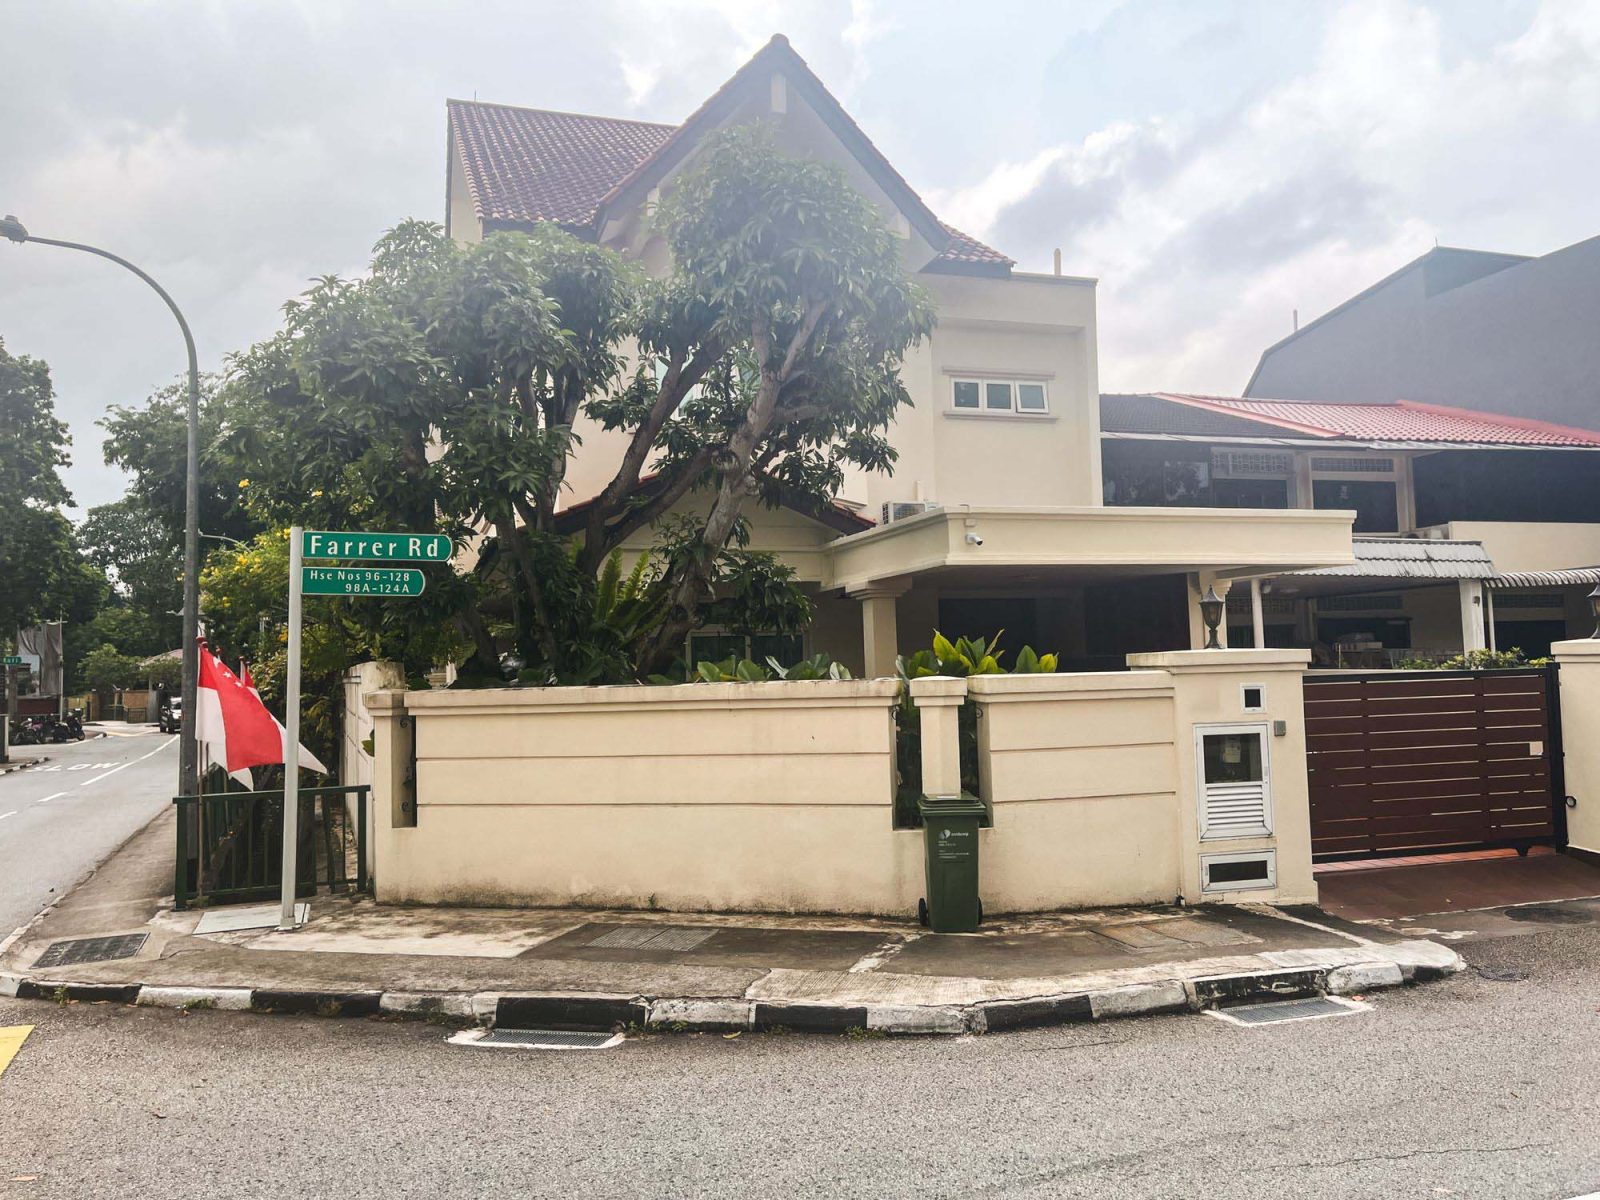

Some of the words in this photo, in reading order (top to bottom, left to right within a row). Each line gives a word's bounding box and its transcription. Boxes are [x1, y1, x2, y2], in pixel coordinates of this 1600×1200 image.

[310, 535, 397, 556] Farrer
[408, 537, 438, 557] Rd
[310, 570, 333, 580] Hse
[337, 571, 361, 581] Nos
[365, 571, 410, 582] 96-128
[345, 583, 410, 593] 98A-124A
[25, 762, 120, 772] SLOW
